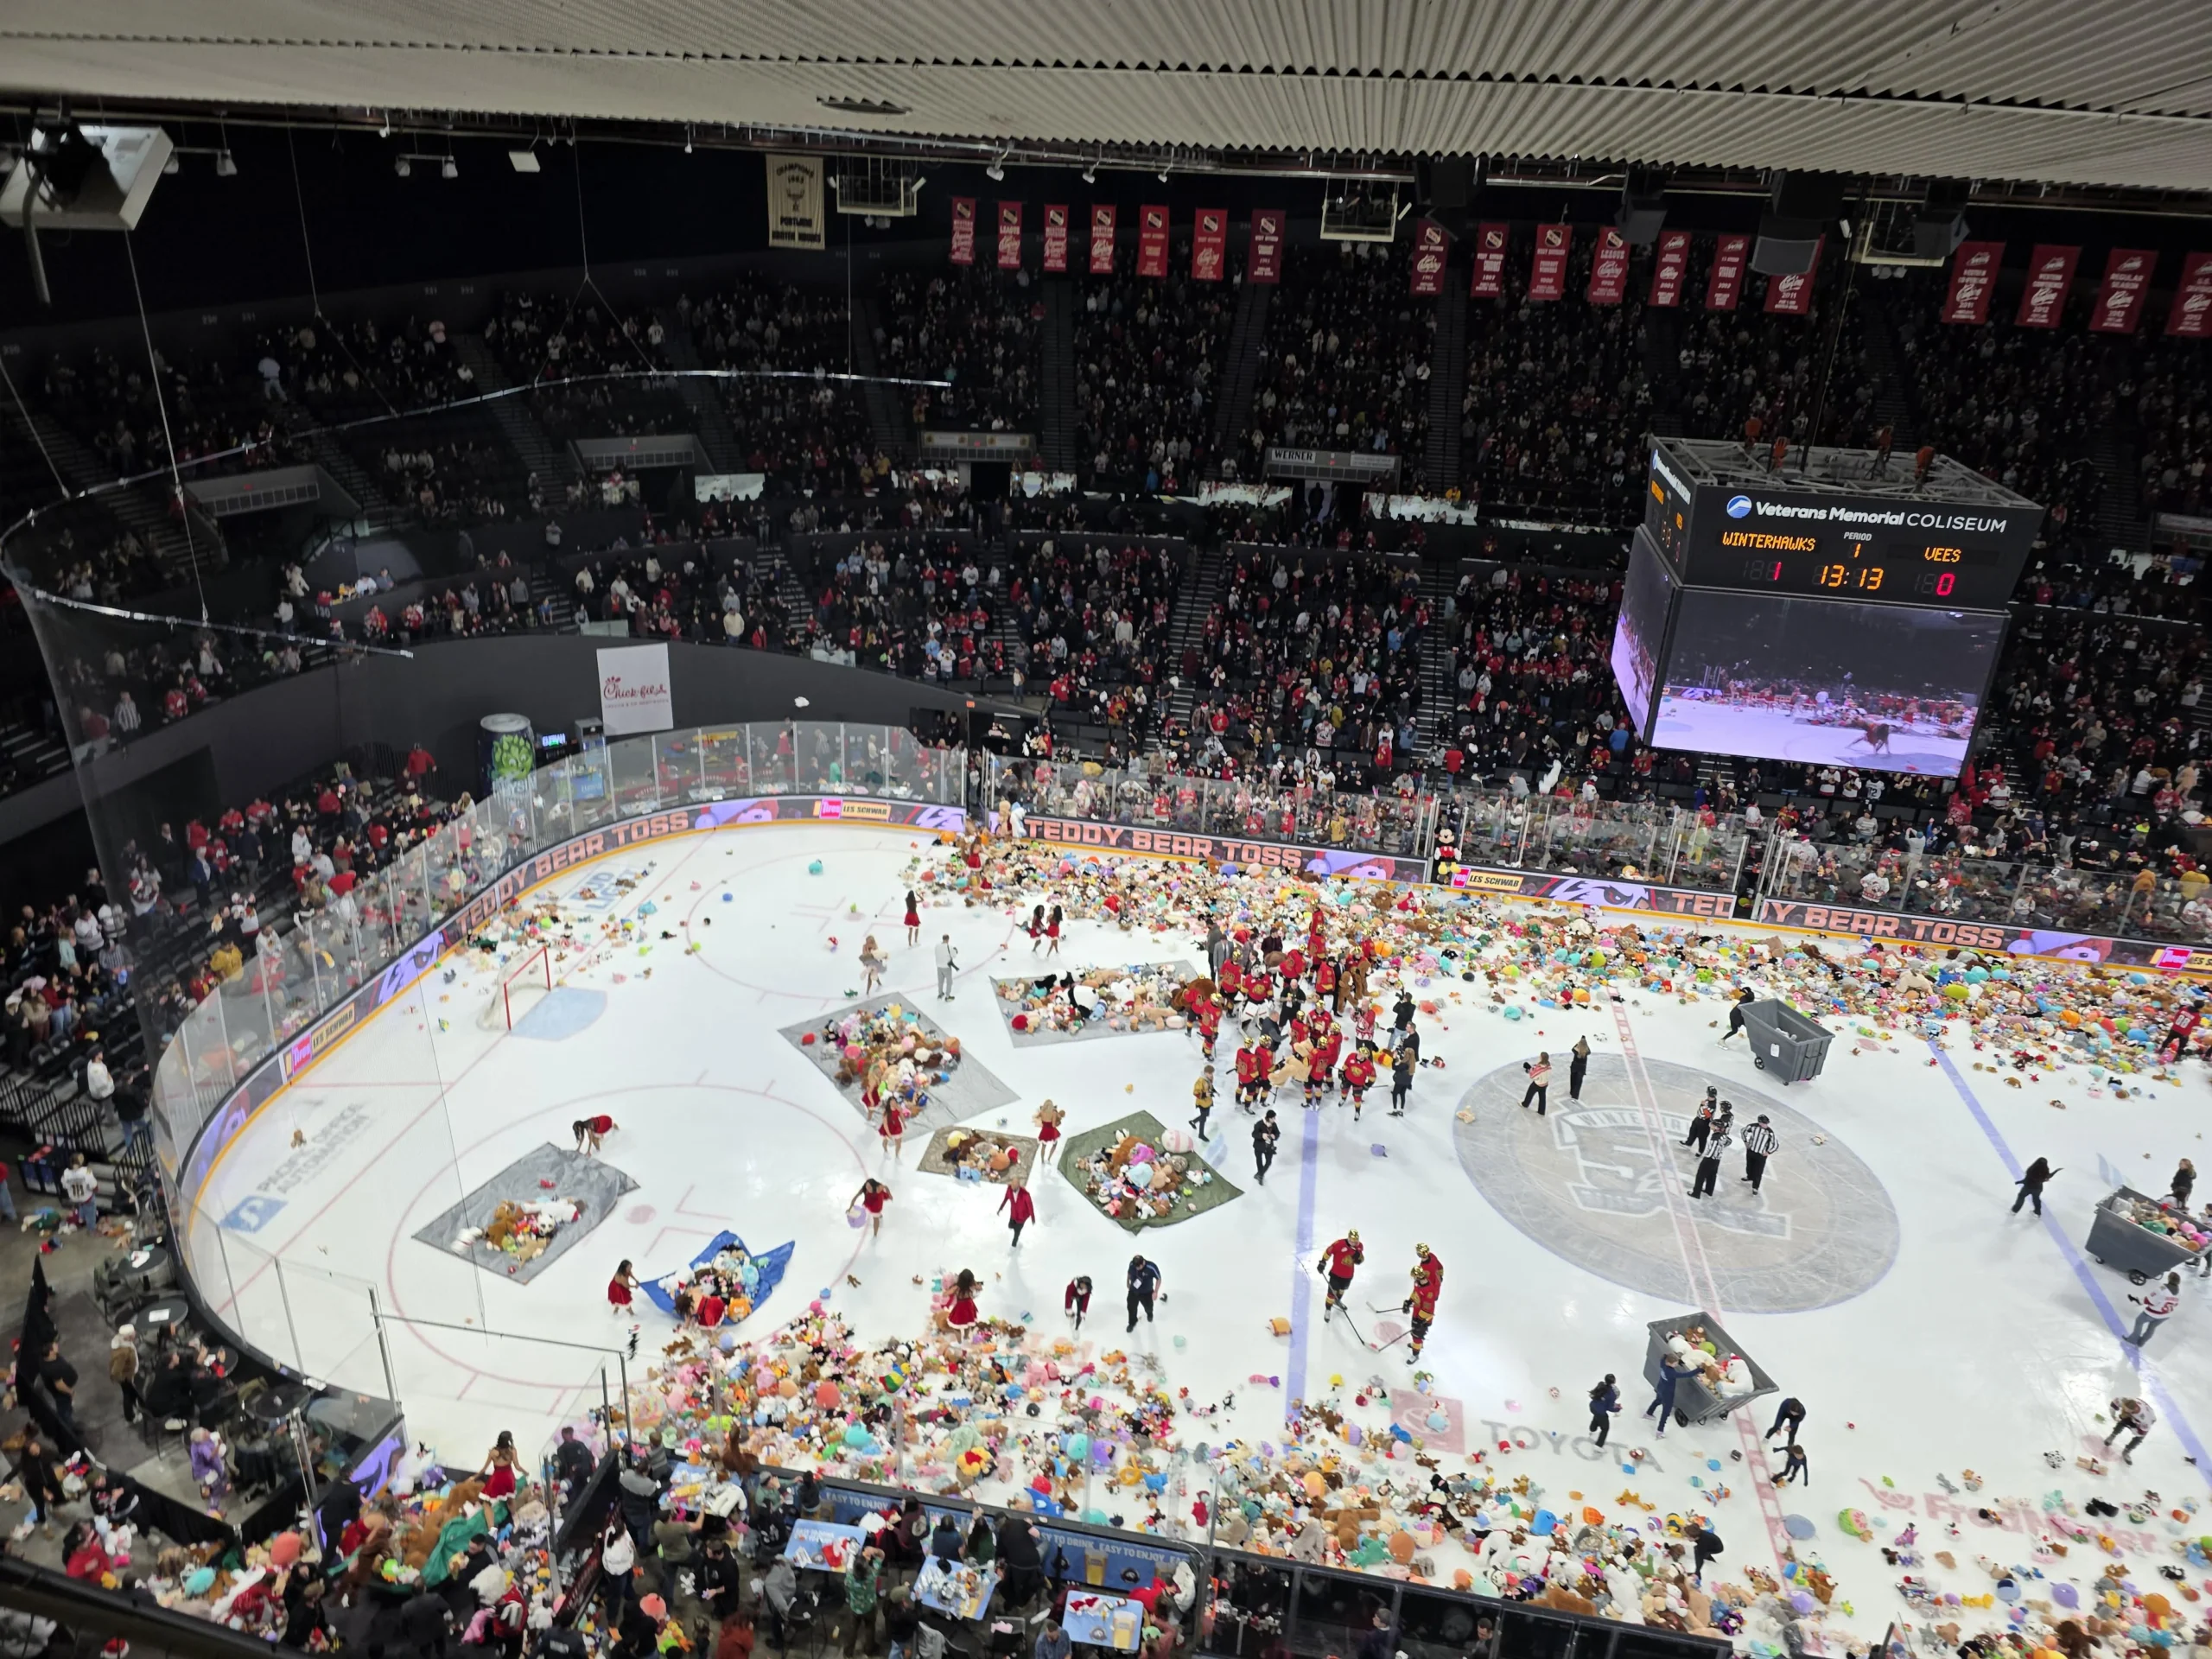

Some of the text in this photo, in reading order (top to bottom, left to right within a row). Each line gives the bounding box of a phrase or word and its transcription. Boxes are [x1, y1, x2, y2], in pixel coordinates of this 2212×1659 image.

[1274, 450, 1313, 461] WERNER
[1756, 501, 2007, 533] Veterans Memorial COLISEUM
[1722, 531, 1816, 551] WINTERHAWKS
[1844, 531, 1872, 542] PERIOD
[1853, 543, 1862, 558] 1
[1924, 547, 1961, 563] VEES
[1774, 562, 1783, 581] 1
[1820, 564, 1885, 591] 13:13
[1936, 572, 1955, 596] 0
[842, 804, 887, 816] LES SCHWAB
[1024, 819, 1302, 868] TEDDY BEAR TOSS
[455, 811, 689, 935] TEDDY BEAR TOSS
[1469, 874, 1520, 887] LES SCHWAB
[1803, 906, 1901, 938] BEAR
[1910, 918, 2005, 950] TOSS
[277, 1115, 370, 1194] AUTOMATION
[257, 1147, 316, 1192] PACIFIC
[1480, 1419, 1665, 1473] TOYOTA
[825, 1491, 889, 1511] EASY TO ENJOY
[1053, 1535, 1065, 1546] TO
[1098, 1542, 1123, 1555] EASY
[1123, 1547, 1135, 1557] TO
